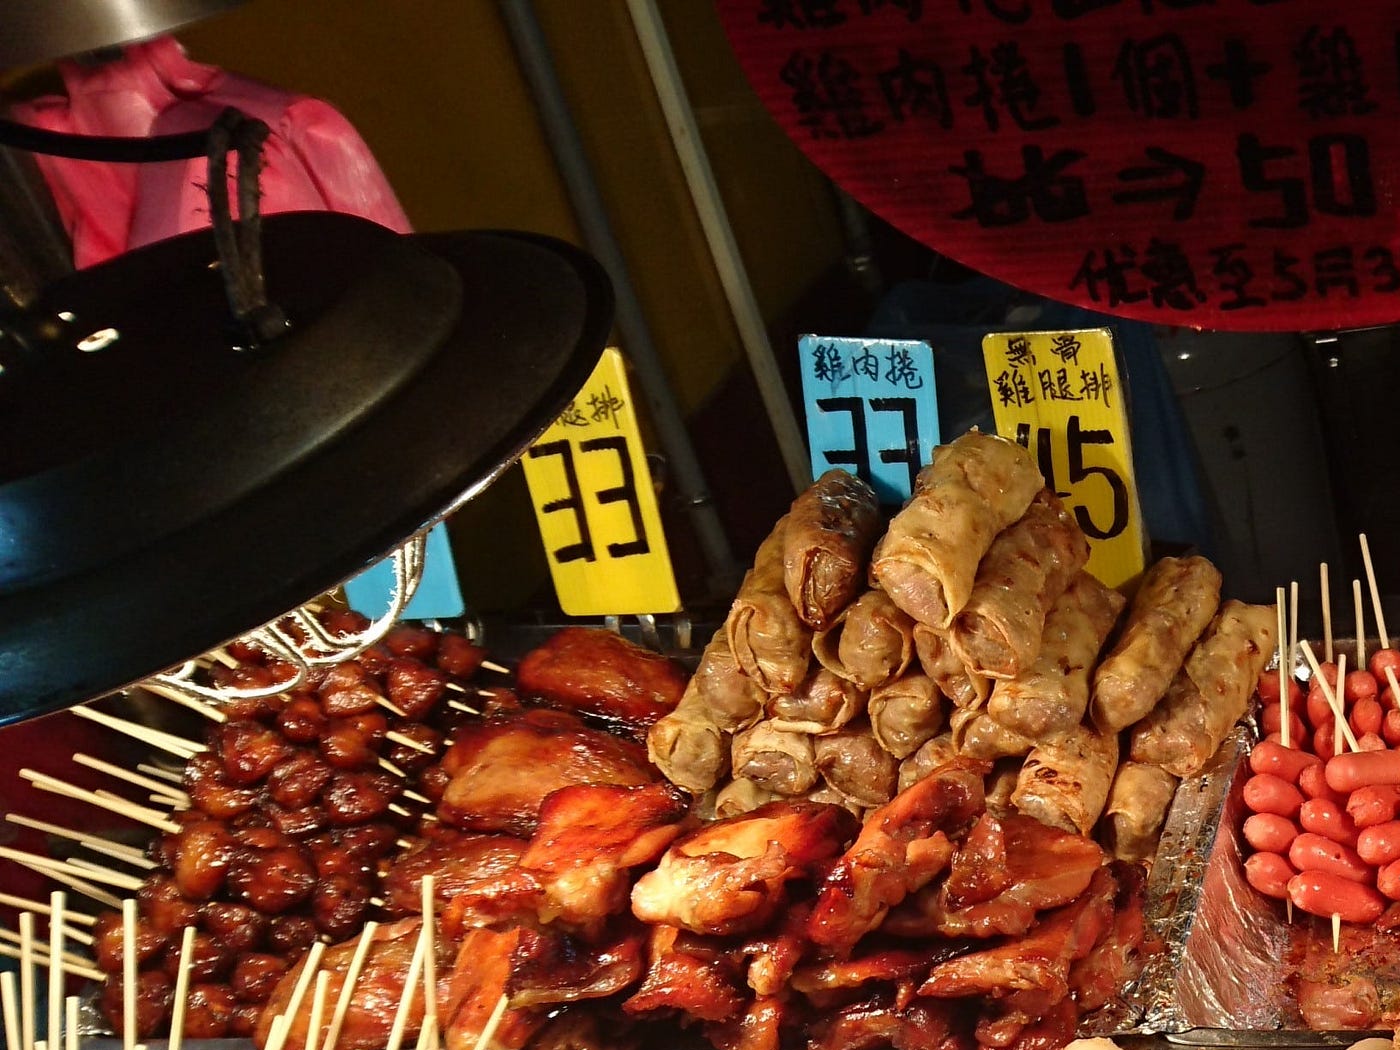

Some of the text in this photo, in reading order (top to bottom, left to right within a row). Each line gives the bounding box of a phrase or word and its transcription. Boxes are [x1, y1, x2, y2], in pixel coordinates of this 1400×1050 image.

[1235, 132, 1376, 228] 50
[813, 344, 924, 389] 雞肉捲
[1005, 337, 1082, 368] 無骨
[993, 363, 1112, 408] 雞腿排
[529, 436, 651, 563] 33
